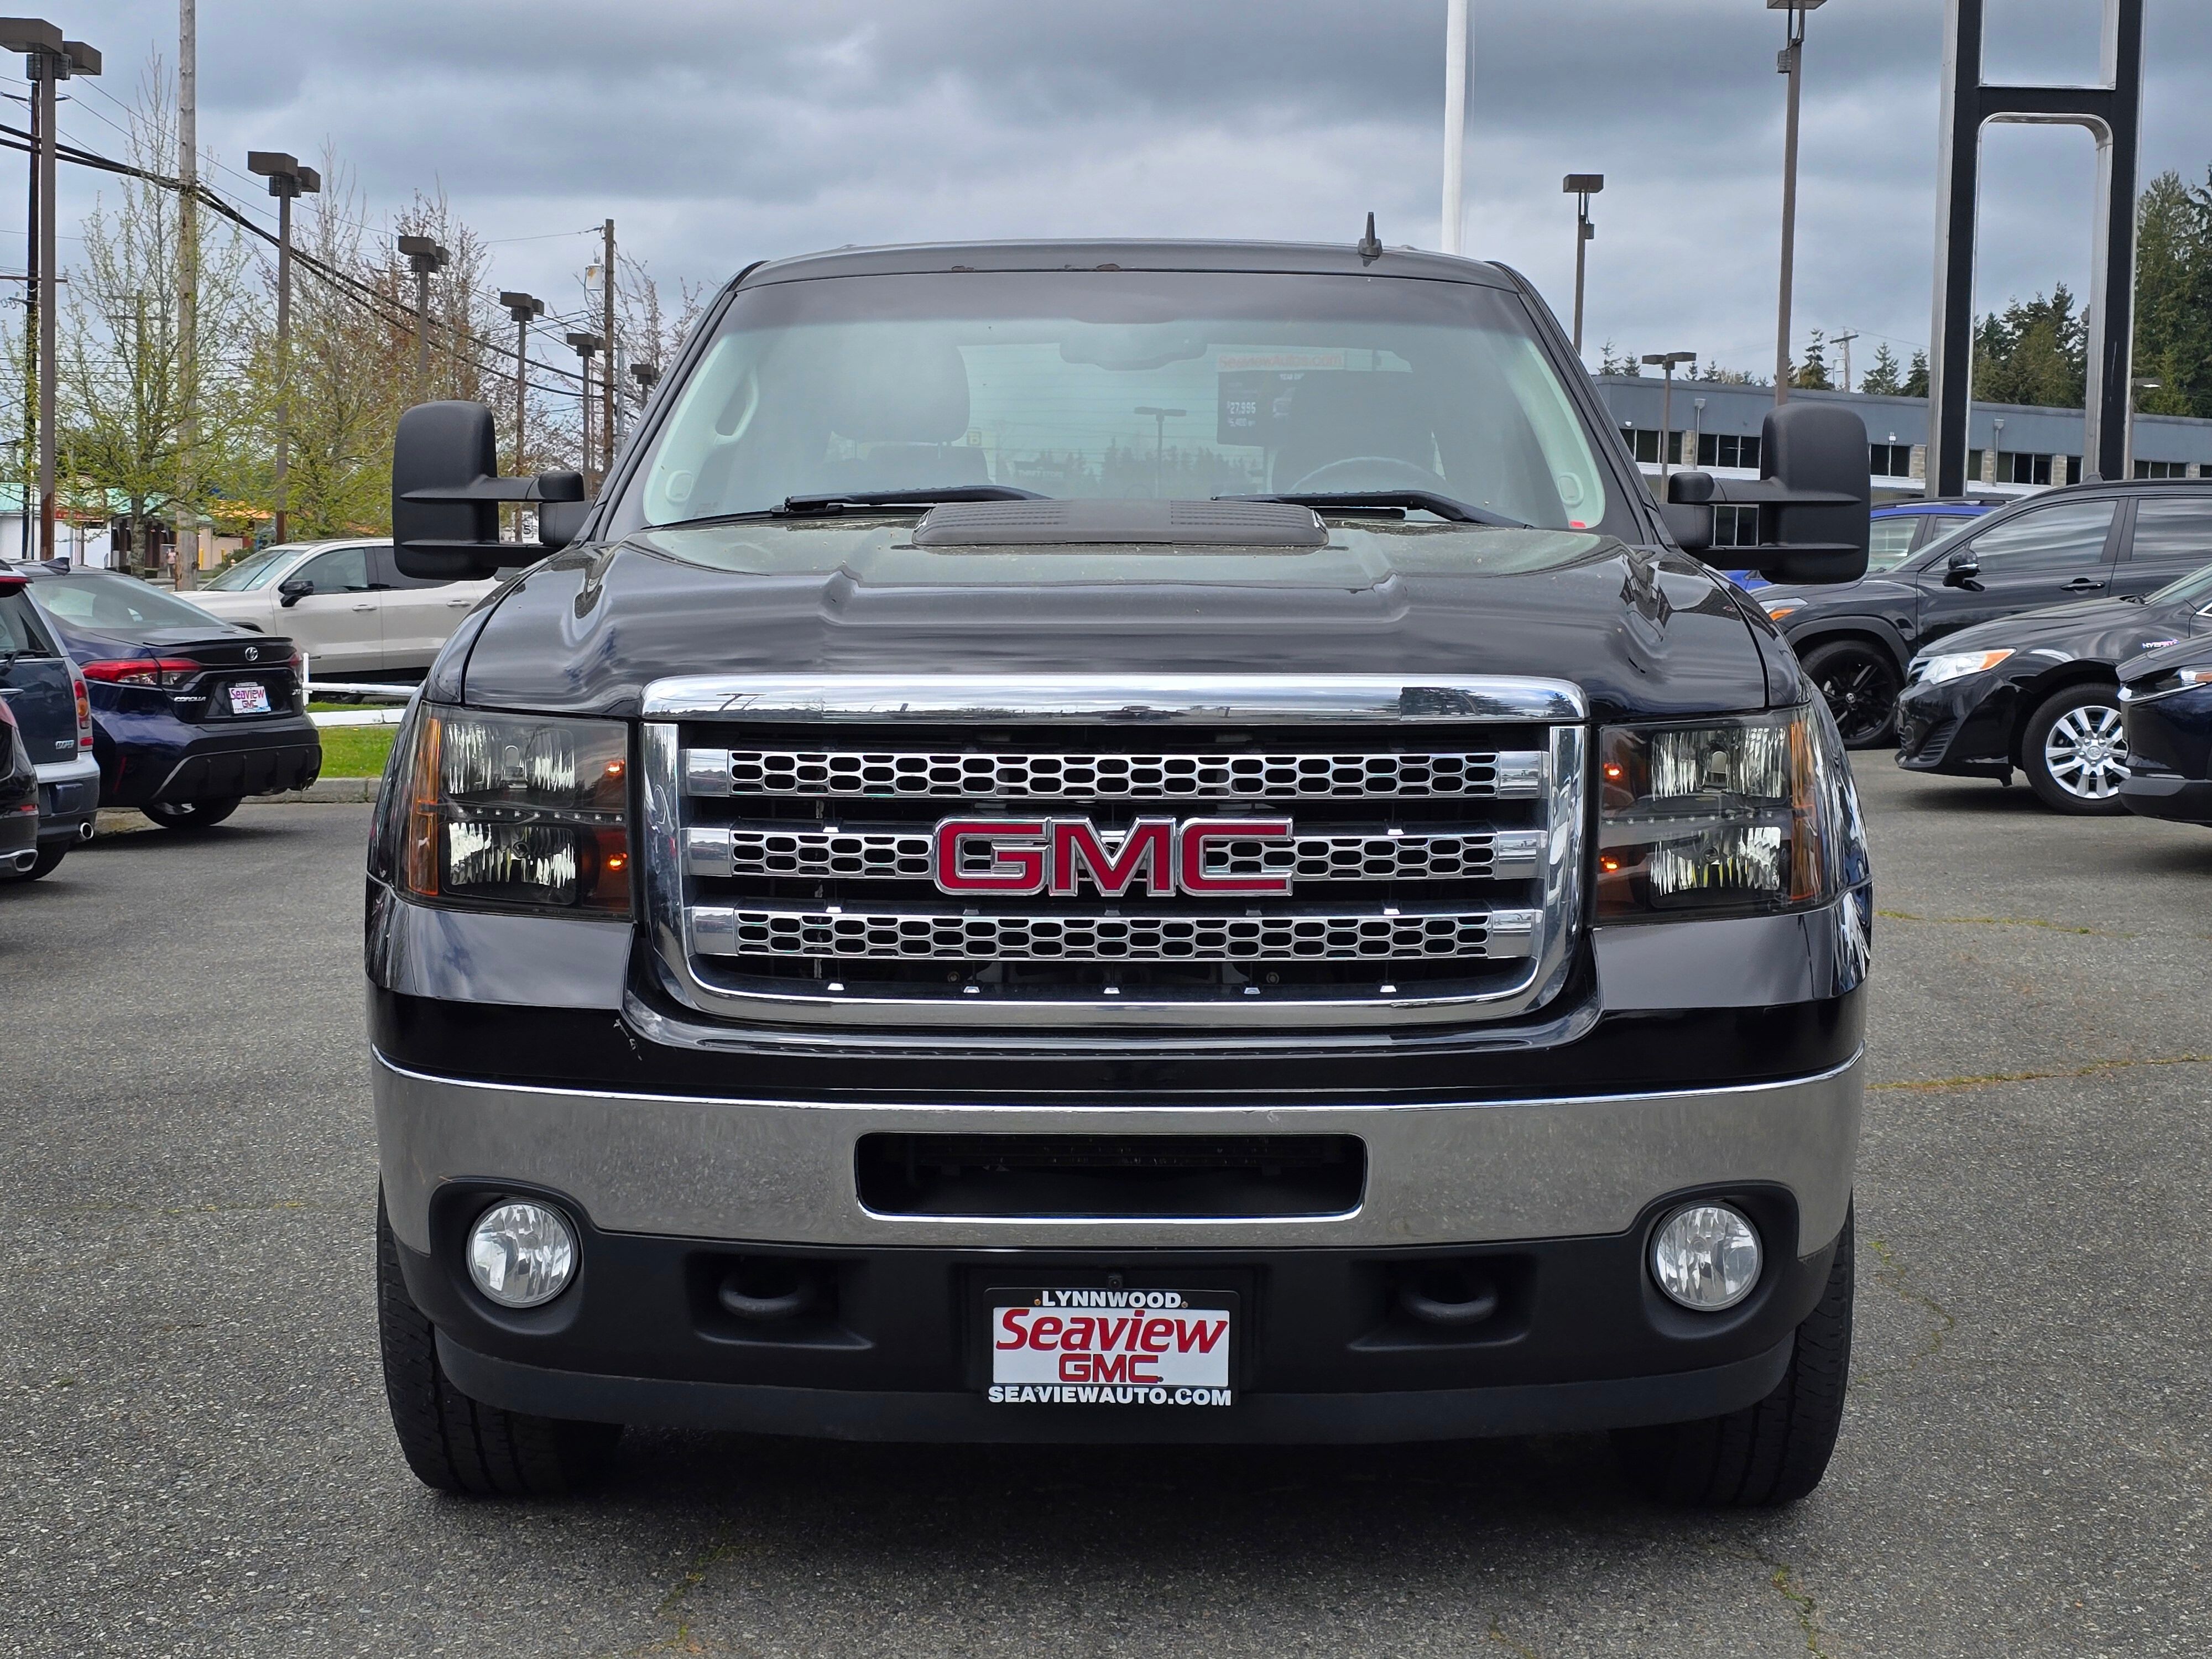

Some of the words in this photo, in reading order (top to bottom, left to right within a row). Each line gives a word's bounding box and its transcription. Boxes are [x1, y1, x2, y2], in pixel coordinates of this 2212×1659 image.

[932, 815, 1294, 896] GMC
[1042, 1290, 1182, 1308] LYNNWOOD
[995, 1308, 1228, 1353] Seaview
[1058, 1353, 1159, 1384] GMC
[988, 1386, 1232, 1406] SEAVIEWAUTO.COM
